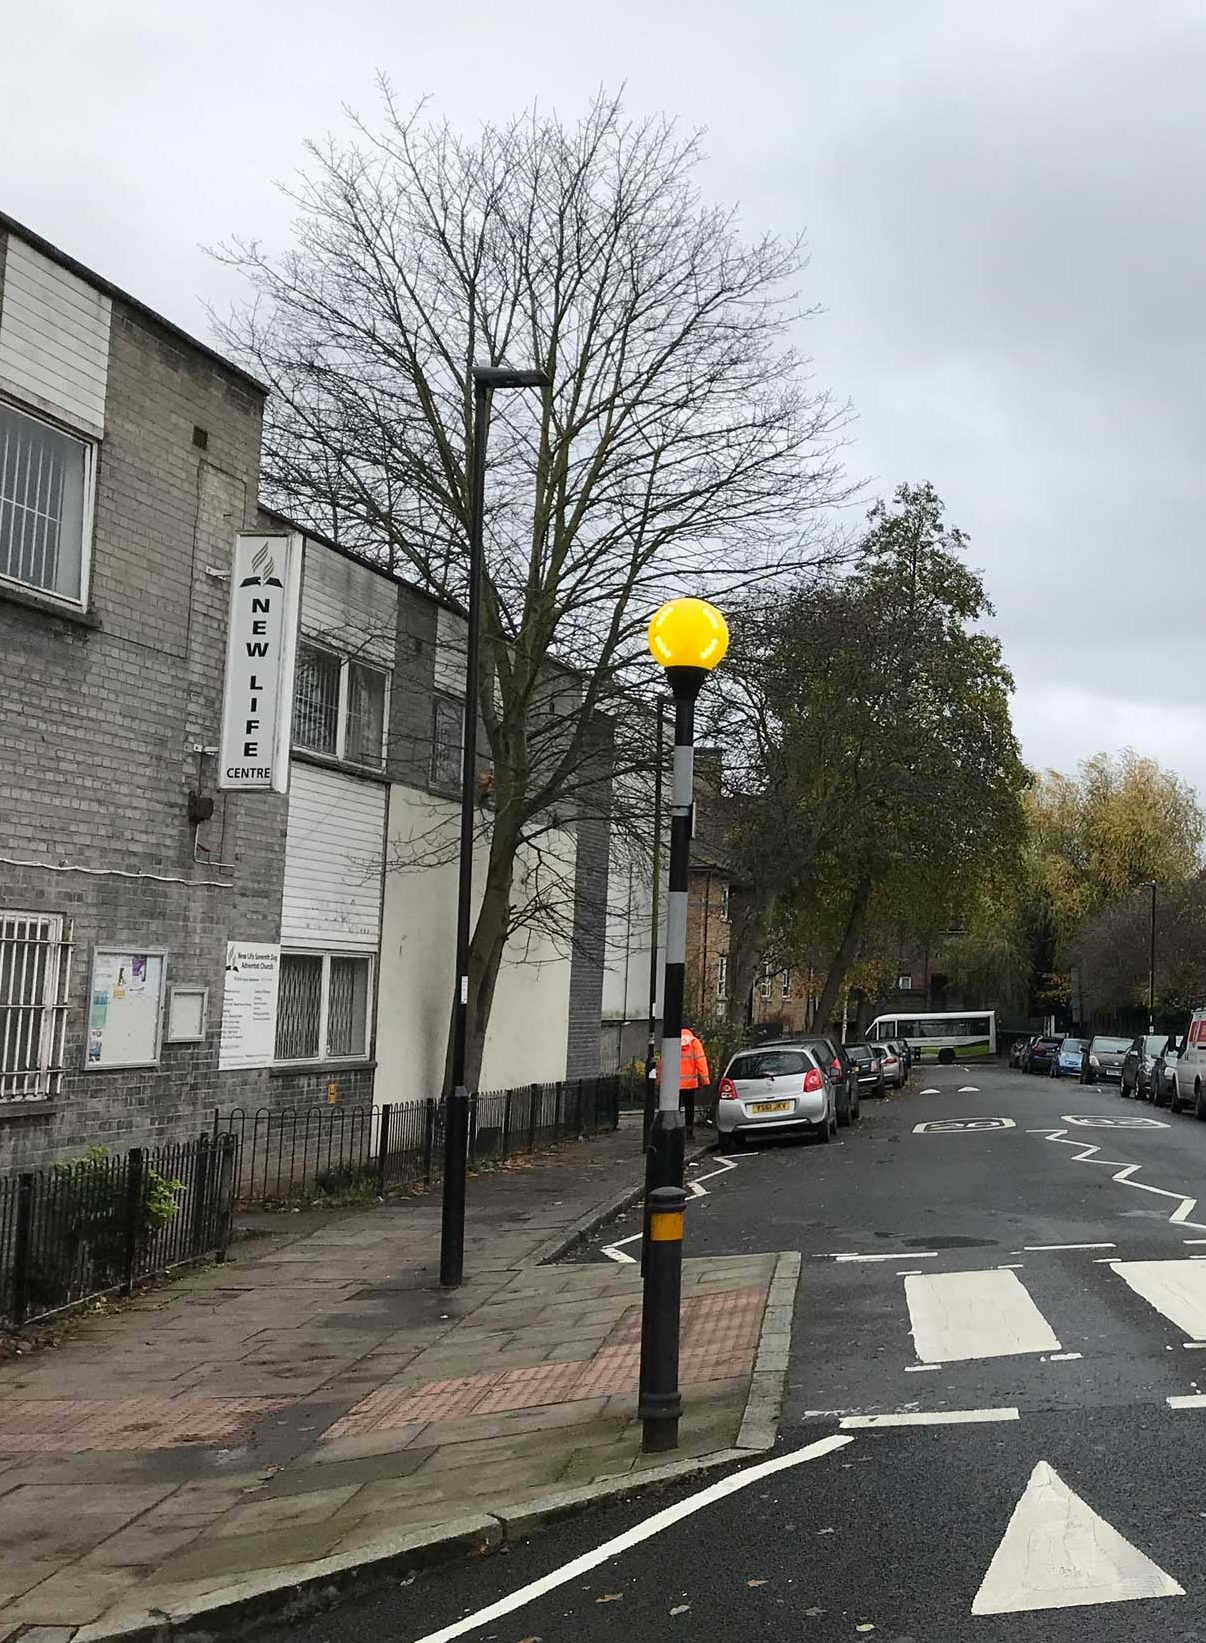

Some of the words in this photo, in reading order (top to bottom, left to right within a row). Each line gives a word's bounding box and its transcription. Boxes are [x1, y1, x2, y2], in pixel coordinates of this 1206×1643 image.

[246, 598, 271, 658] NEW
[243, 675, 264, 758] LIFE
[226, 767, 271, 779] CENTRE
[260, 962, 274, 971] Church
